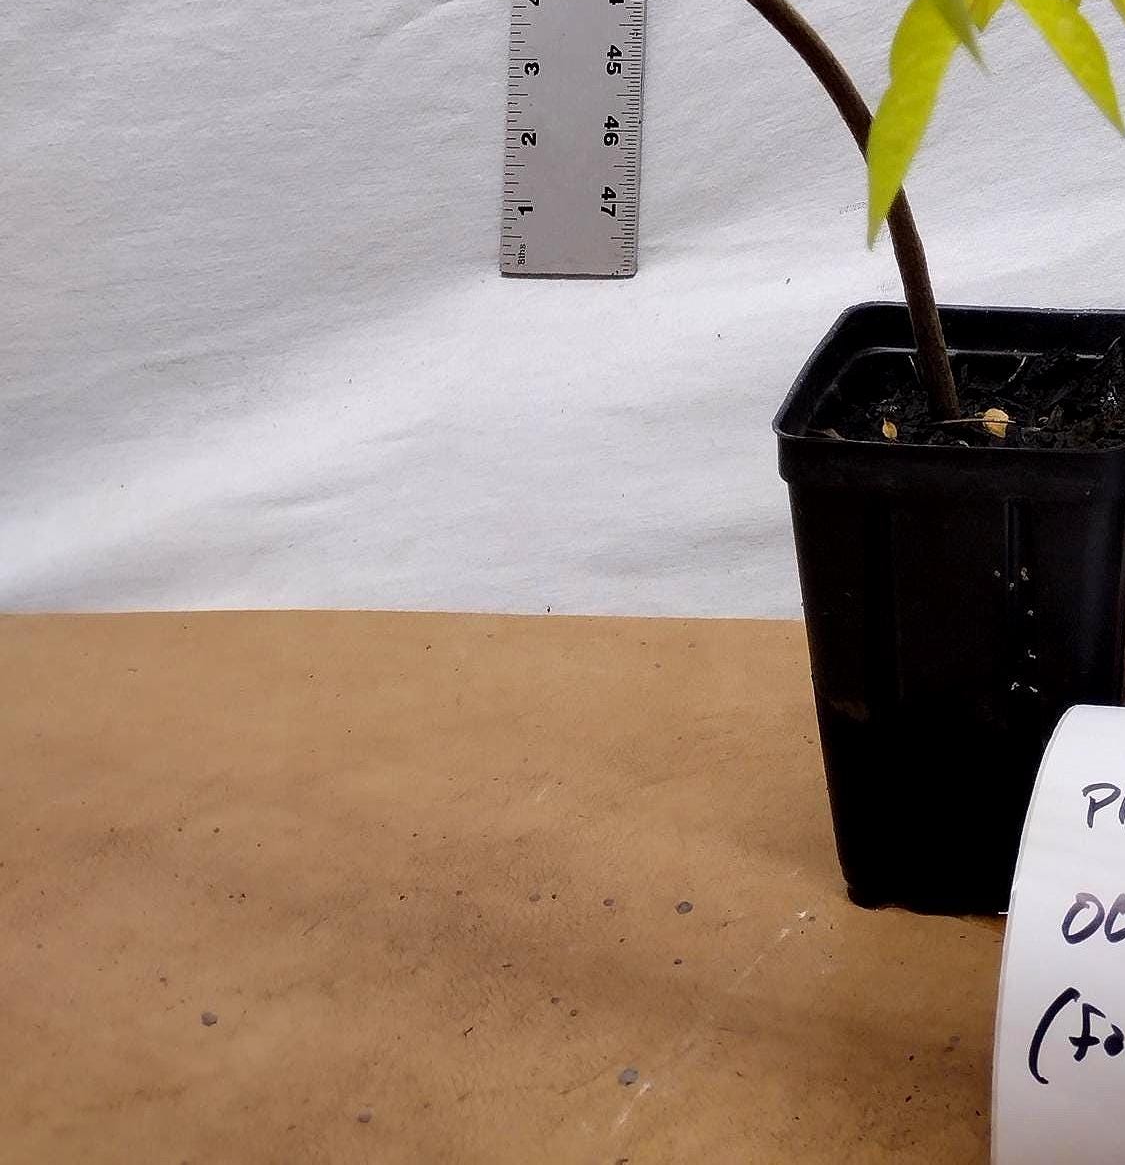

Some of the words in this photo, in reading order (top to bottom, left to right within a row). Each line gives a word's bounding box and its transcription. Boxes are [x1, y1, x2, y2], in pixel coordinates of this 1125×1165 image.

[524, 62, 539, 76] 3
[607, 45, 622, 75] 45
[521, 133, 536, 146] 2
[604, 115, 619, 146] 46
[518, 206, 533, 215] 1
[600, 186, 616, 217] 47
